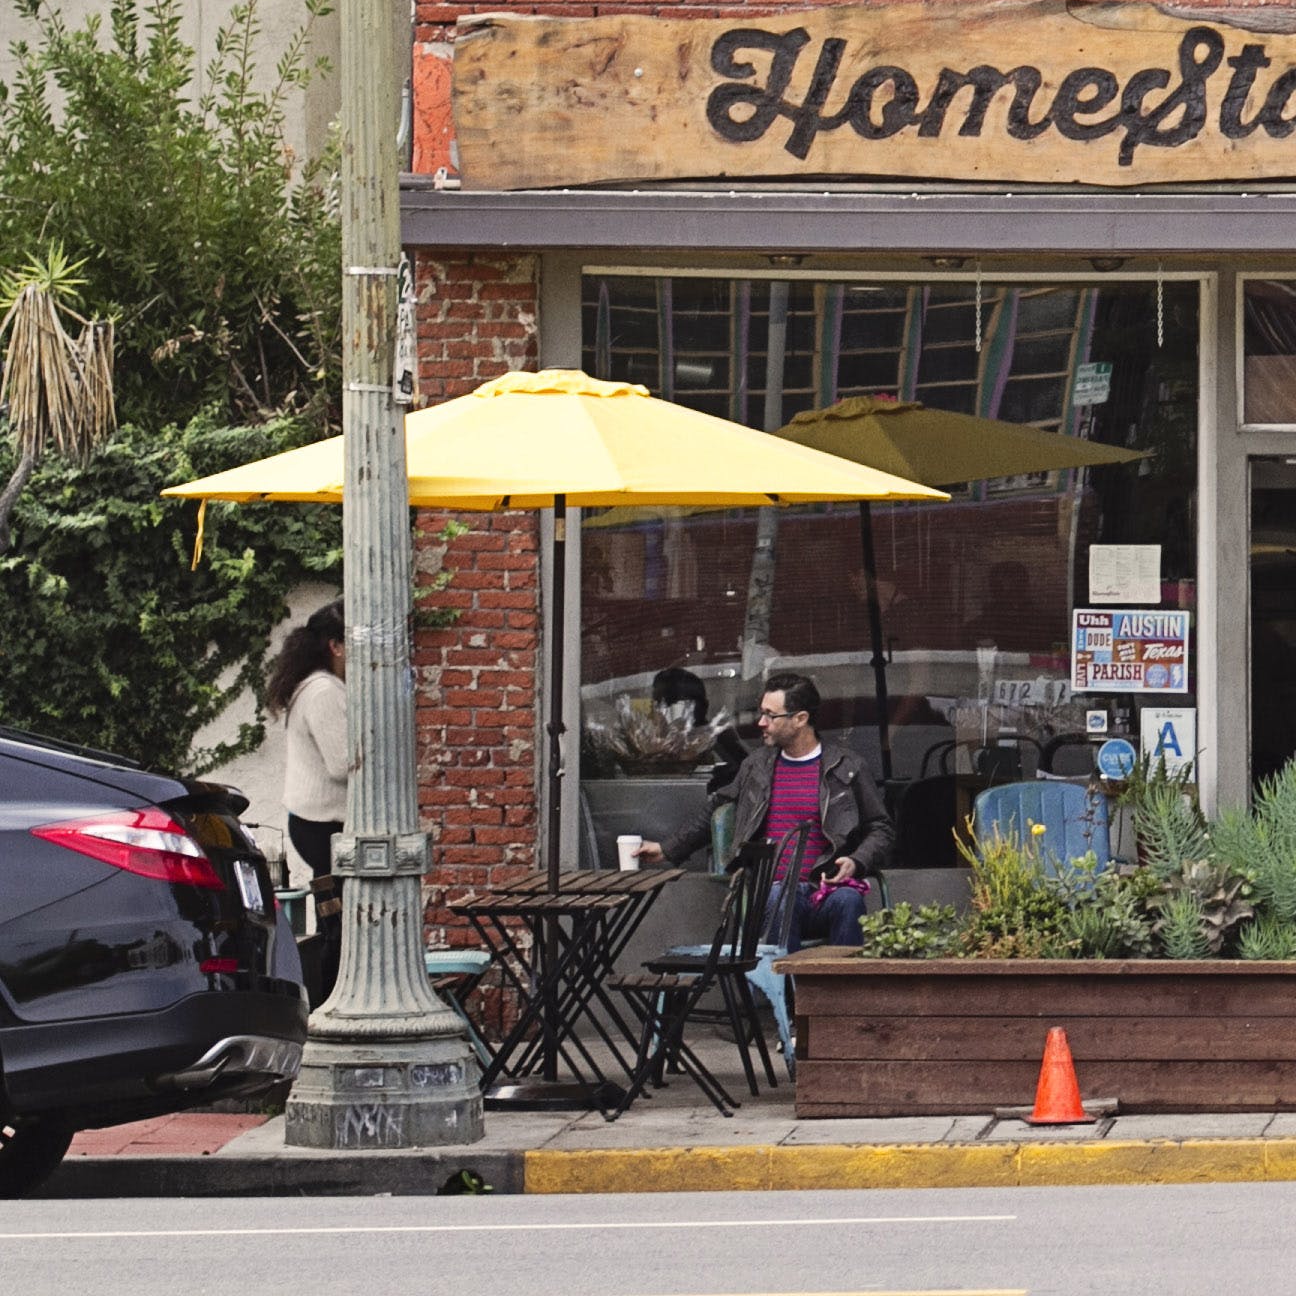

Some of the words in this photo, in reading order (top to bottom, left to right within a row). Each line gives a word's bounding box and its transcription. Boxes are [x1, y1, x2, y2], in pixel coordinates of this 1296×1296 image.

[1079, 614, 1109, 625] Uhh
[1119, 615, 1181, 638] AUSTIN
[1087, 632, 1112, 646] DUDE
[1142, 642, 1184, 661] Texas
[1092, 664, 1143, 680] PARISH
[1154, 721, 1182, 757] A
